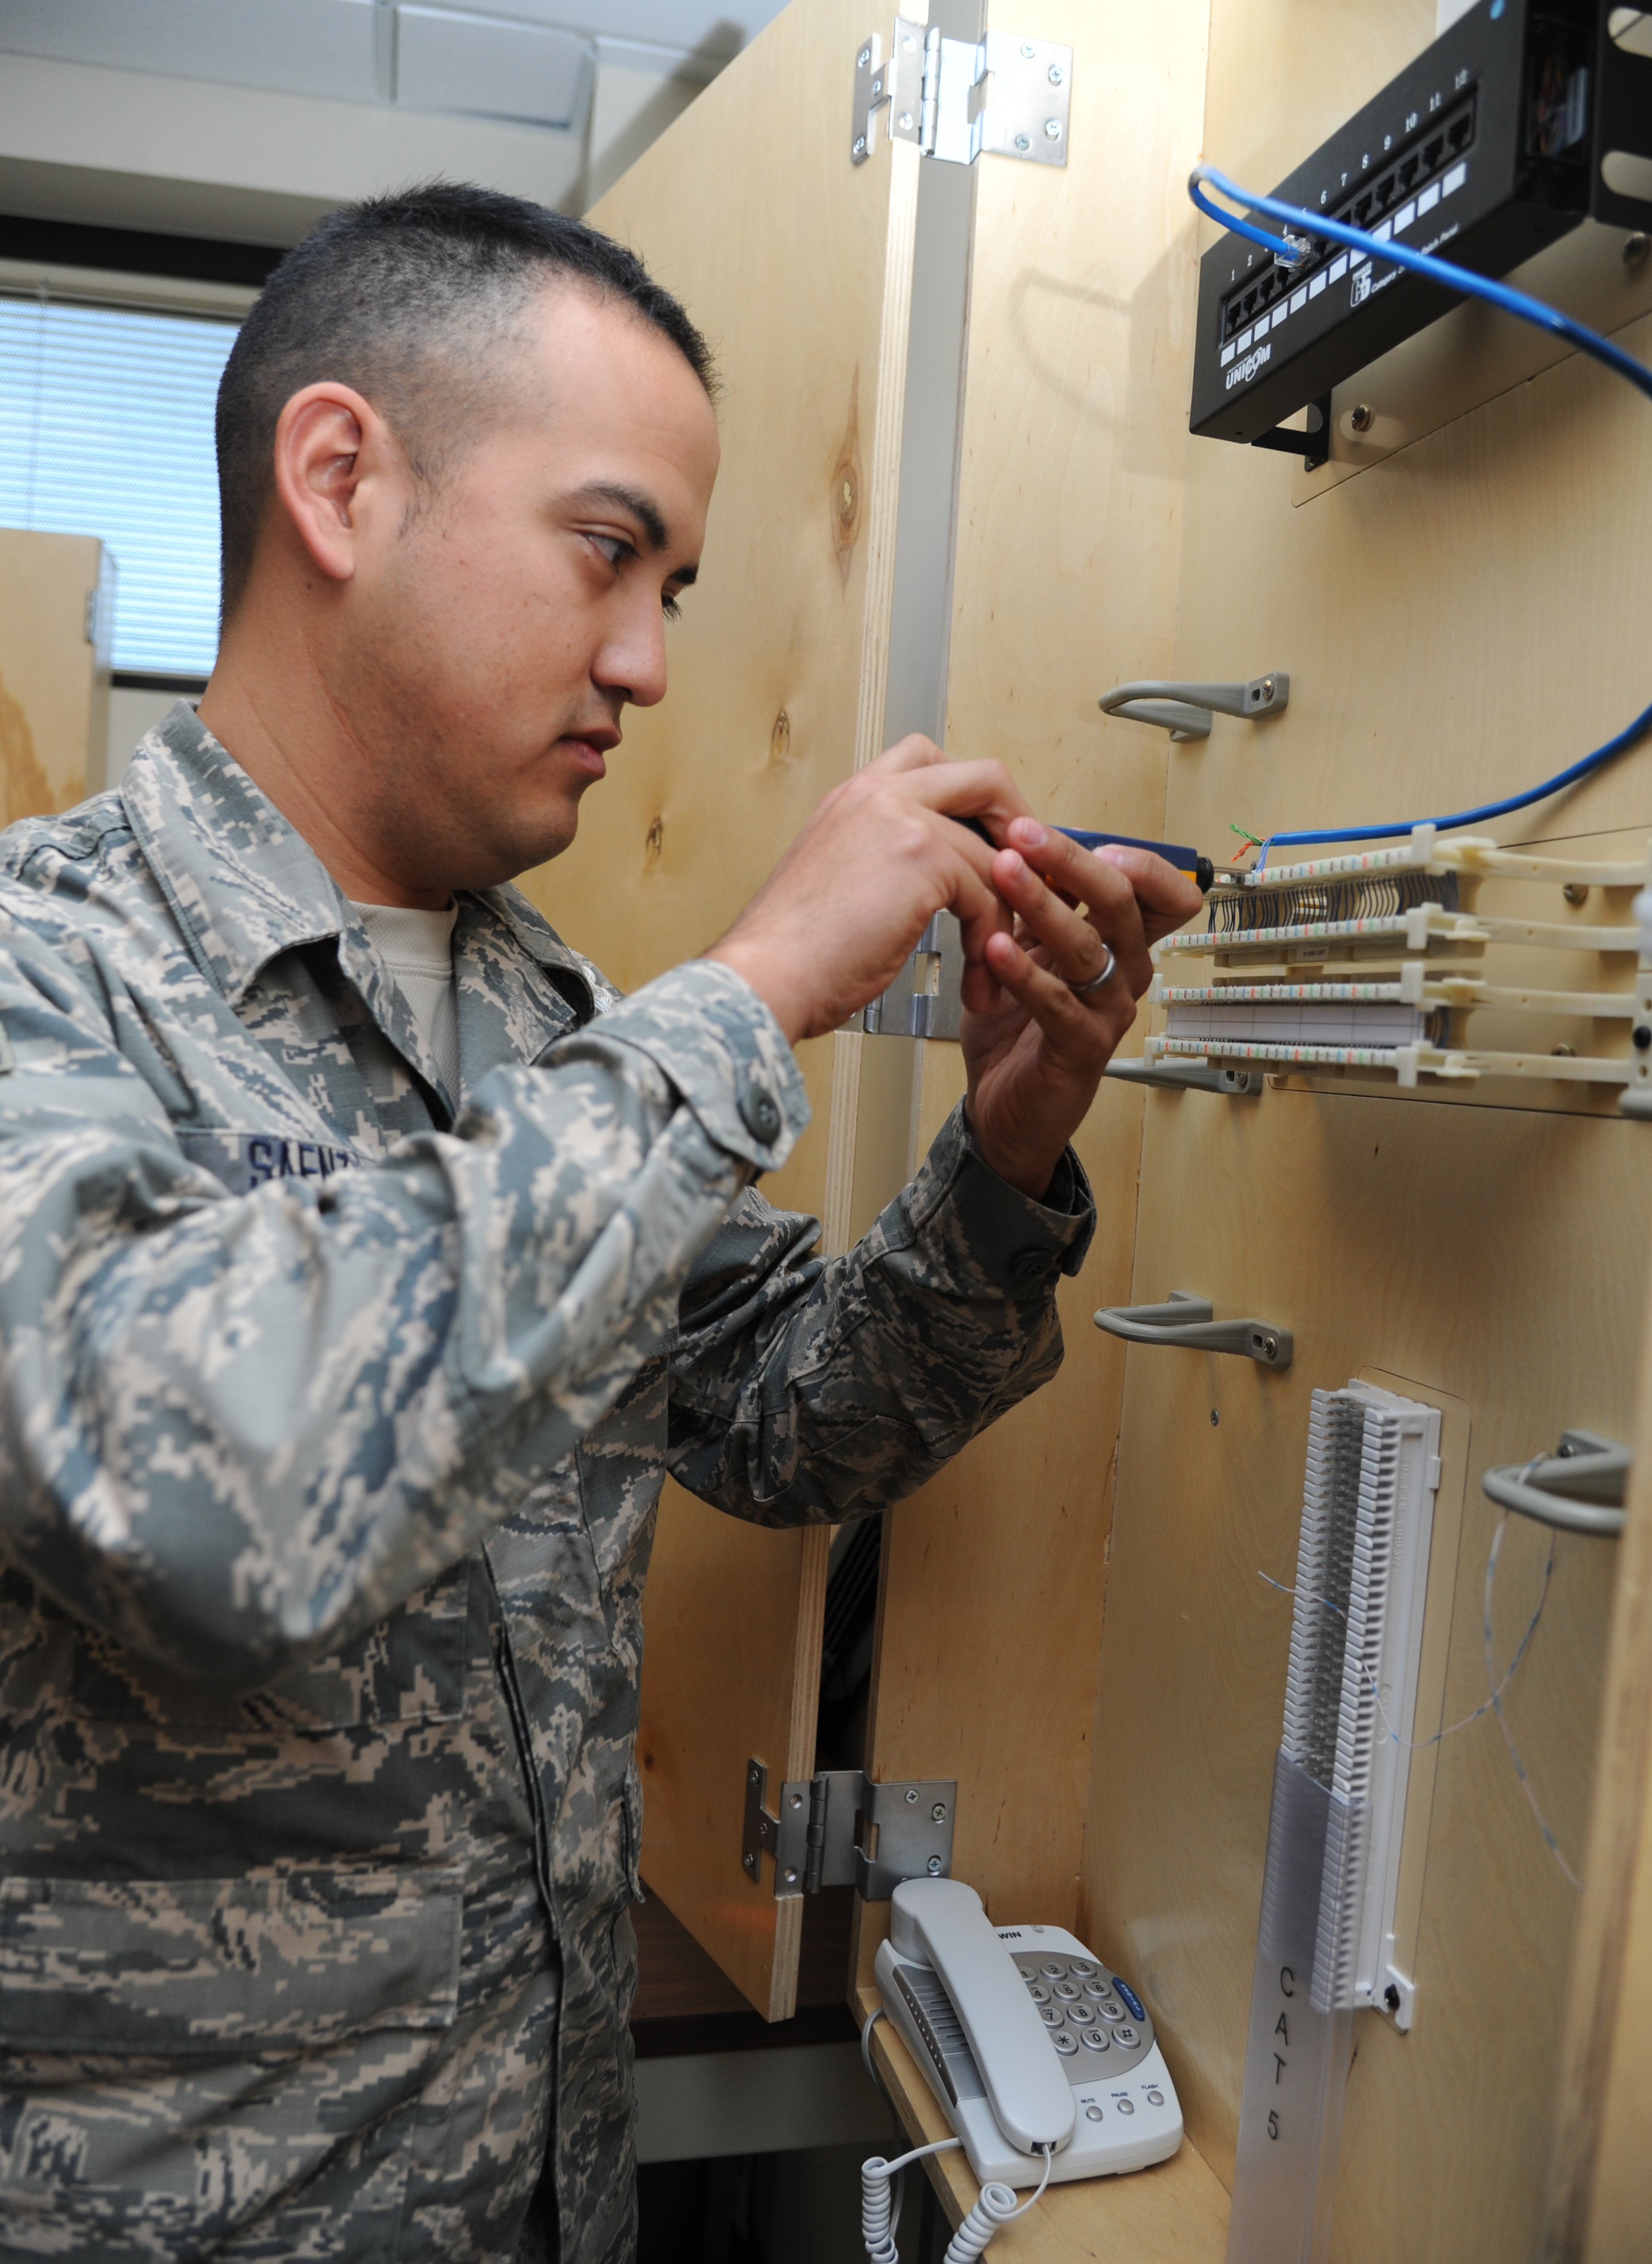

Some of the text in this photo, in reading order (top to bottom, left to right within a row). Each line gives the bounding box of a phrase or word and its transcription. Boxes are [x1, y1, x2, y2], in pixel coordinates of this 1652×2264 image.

[1231, 68, 1469, 281] 1 2 4 6 7 8 9 10 11 12
[1371, 270, 1396, 293] Category
[1226, 343, 1271, 390] UNICOM
[1079, 2008, 1088, 2017] 8
[1109, 2006, 1117, 2014] 9
[1045, 2012, 1053, 2020] 7
[1092, 2033, 1101, 2042] 0
